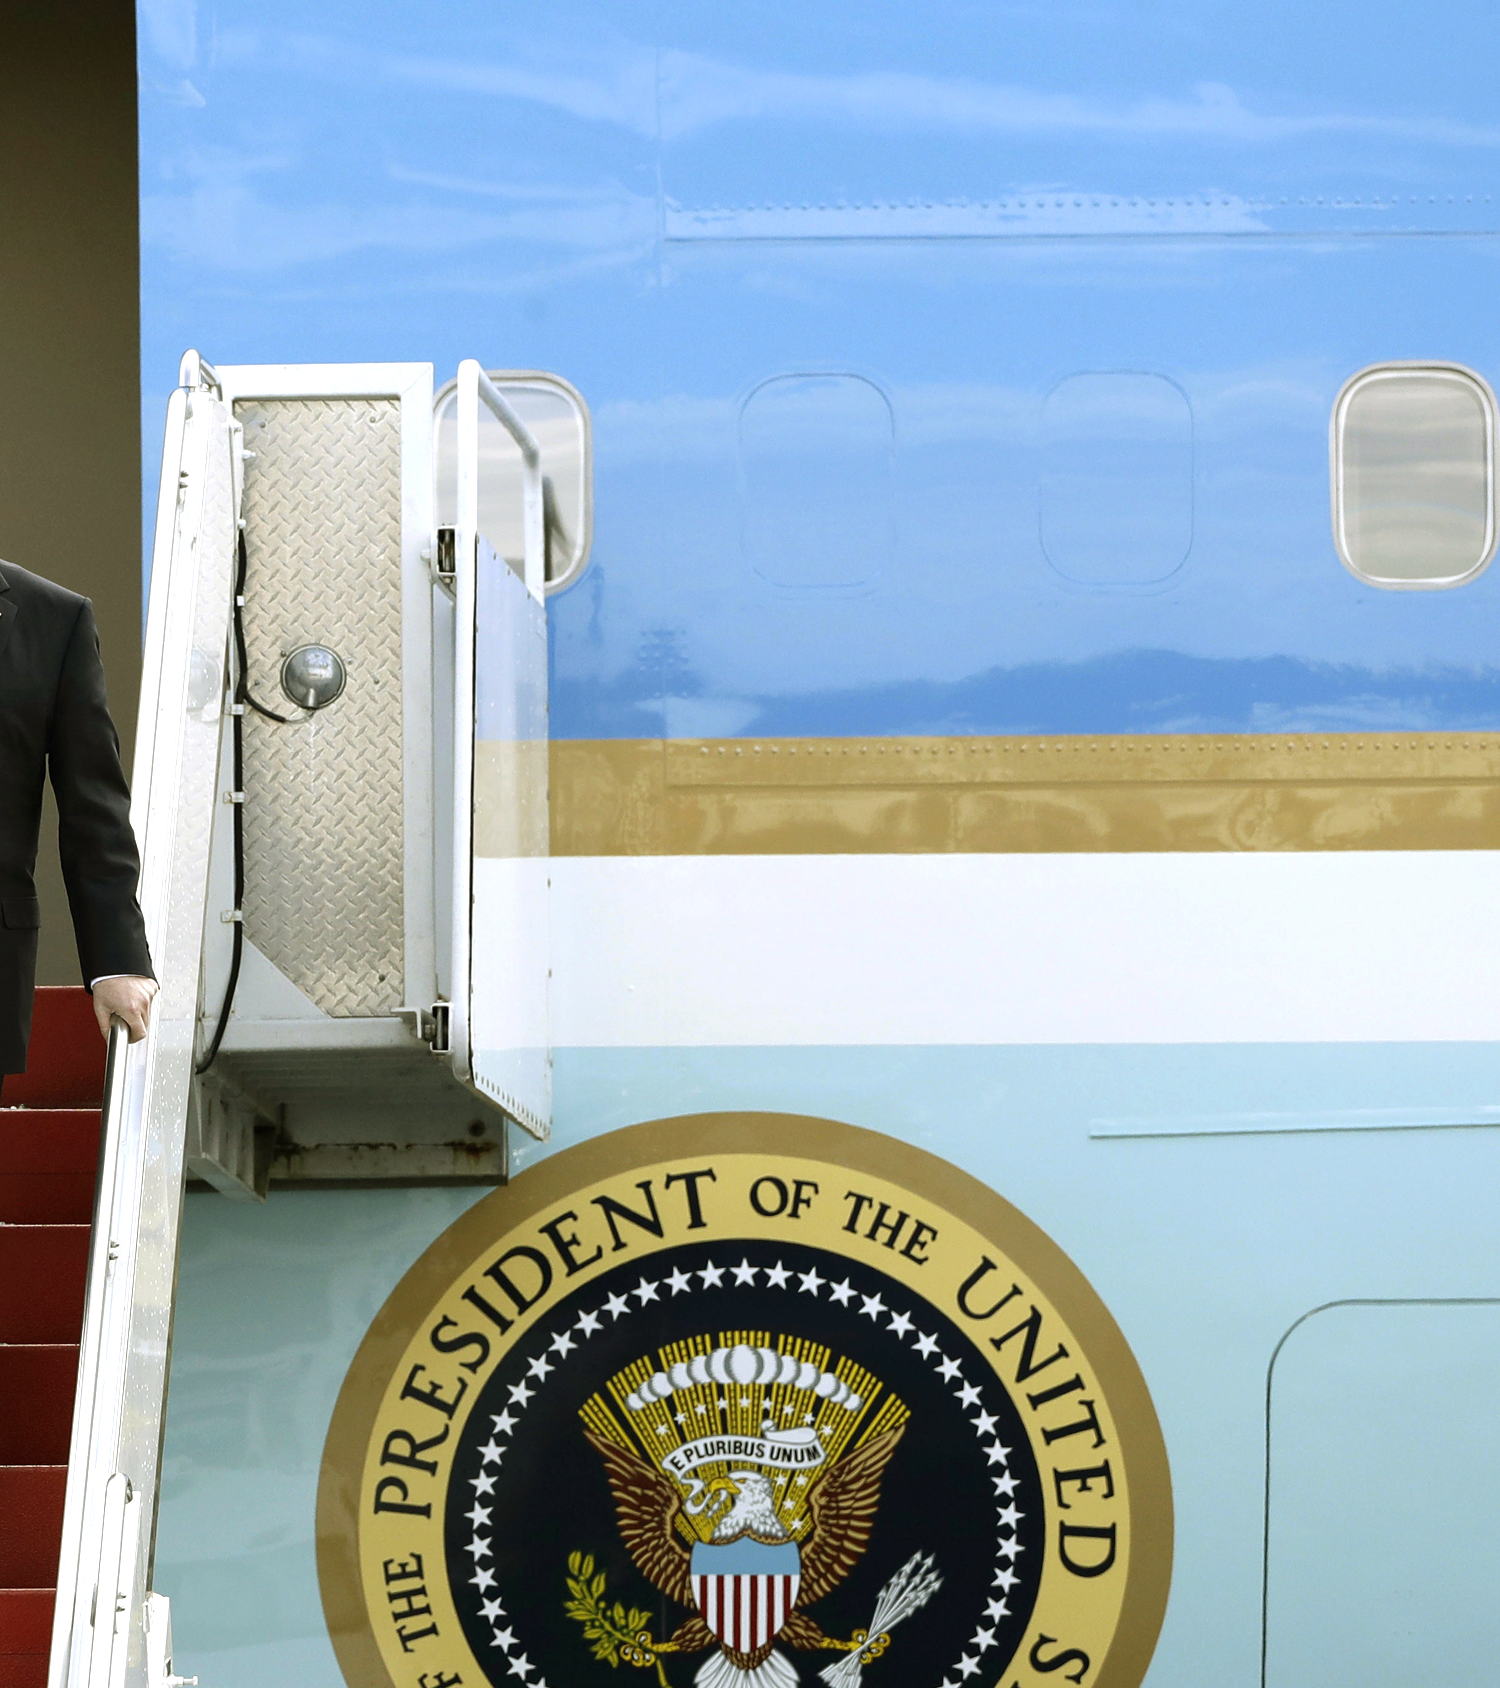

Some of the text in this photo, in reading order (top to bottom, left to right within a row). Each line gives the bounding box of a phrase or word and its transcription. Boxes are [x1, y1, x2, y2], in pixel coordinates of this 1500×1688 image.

[749, 1175, 820, 1219] OF
[842, 1190, 939, 1266] THE
[373, 1167, 717, 1520] PRESIDENT
[669, 1440, 822, 1472] E PLURIBUS UNUM
[956, 1255, 1117, 1579] UNITED
[382, 1552, 440, 1653] THE
